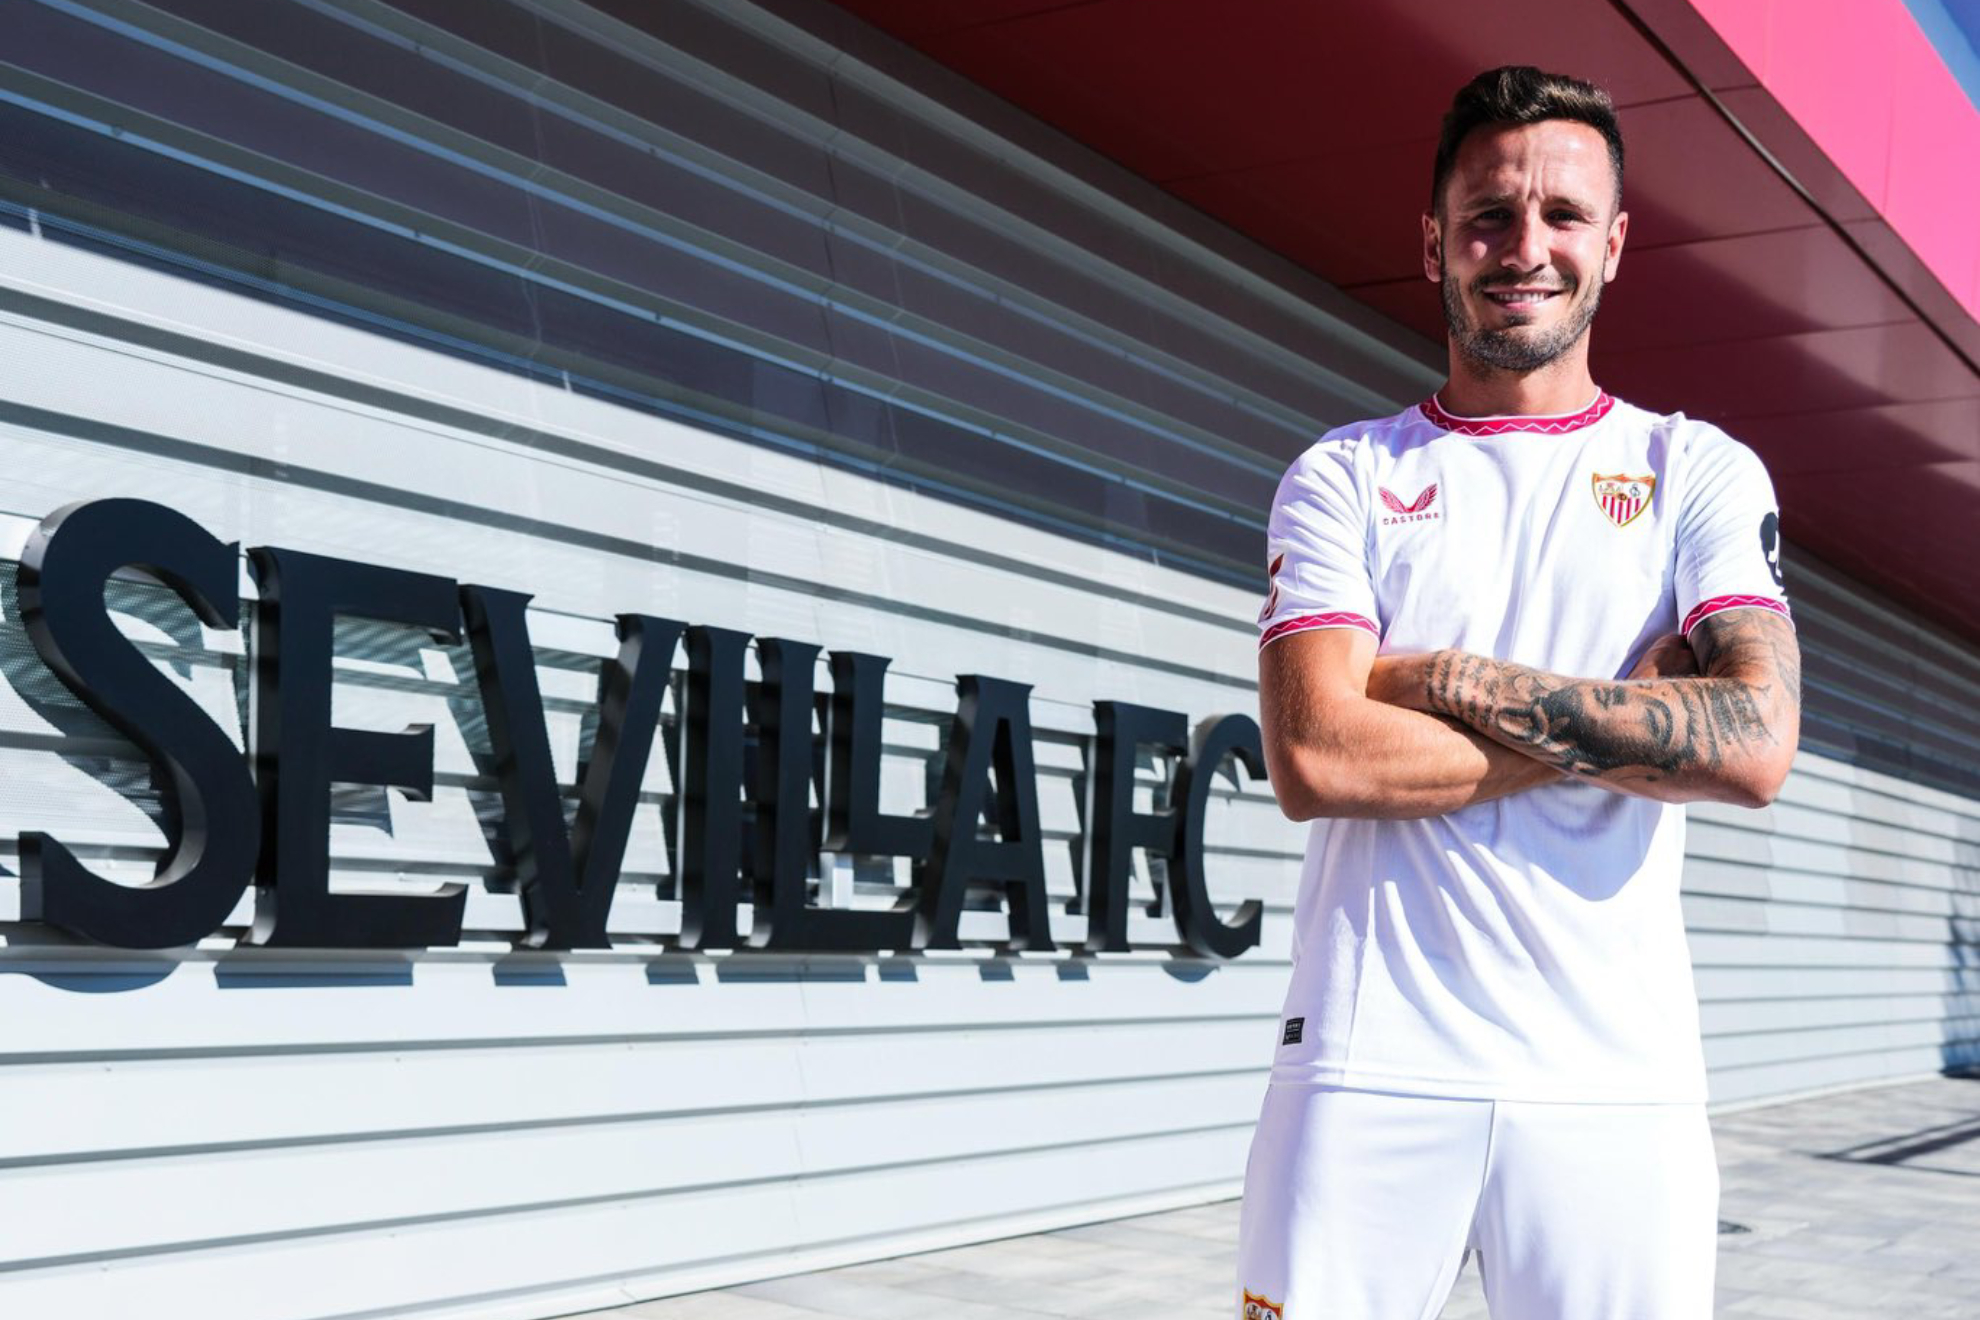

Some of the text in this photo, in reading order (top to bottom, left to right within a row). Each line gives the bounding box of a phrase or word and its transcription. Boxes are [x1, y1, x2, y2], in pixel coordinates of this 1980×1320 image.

[1383, 512, 1440, 526] CASTORE
[18, 497, 1267, 959] SEVILLA FC
